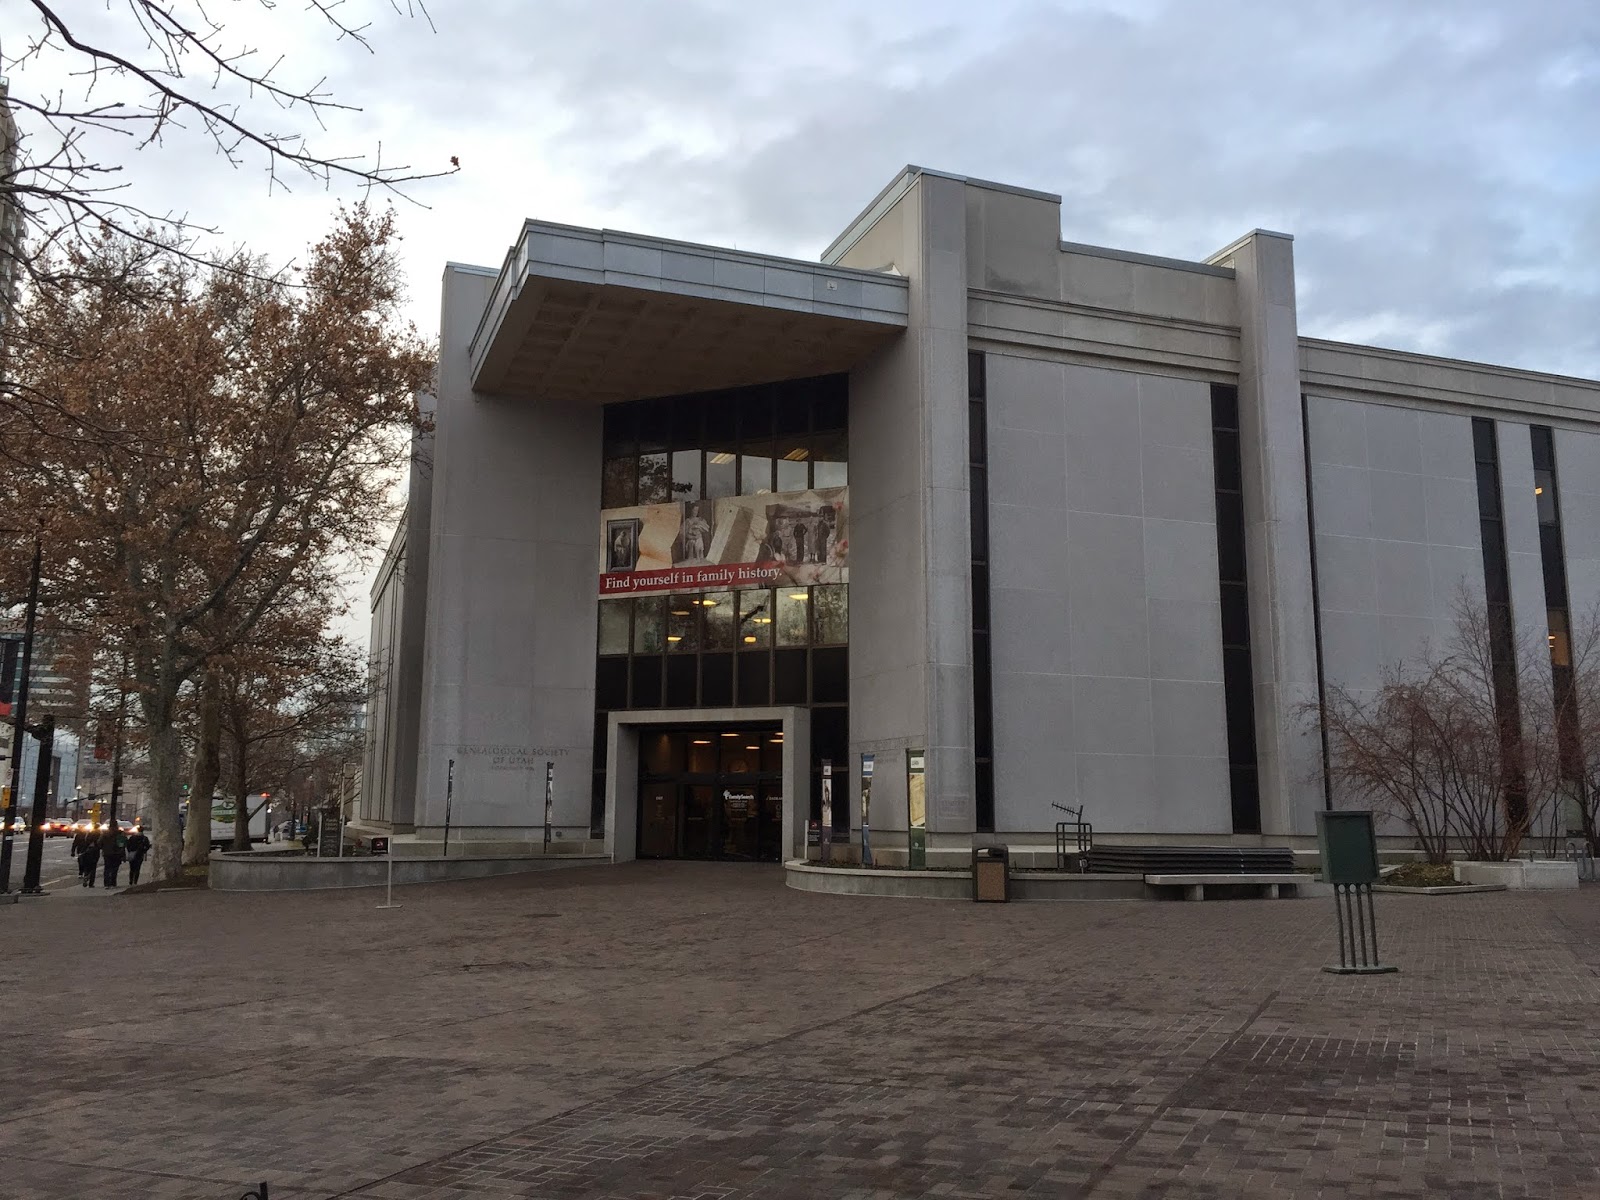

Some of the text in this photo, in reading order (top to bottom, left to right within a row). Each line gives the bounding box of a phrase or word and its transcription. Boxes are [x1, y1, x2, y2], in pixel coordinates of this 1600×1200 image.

[605, 567, 783, 590] Find yourself in family history.
[532, 748, 570, 756] SOCIETY
[509, 757, 534, 765] UTAH
